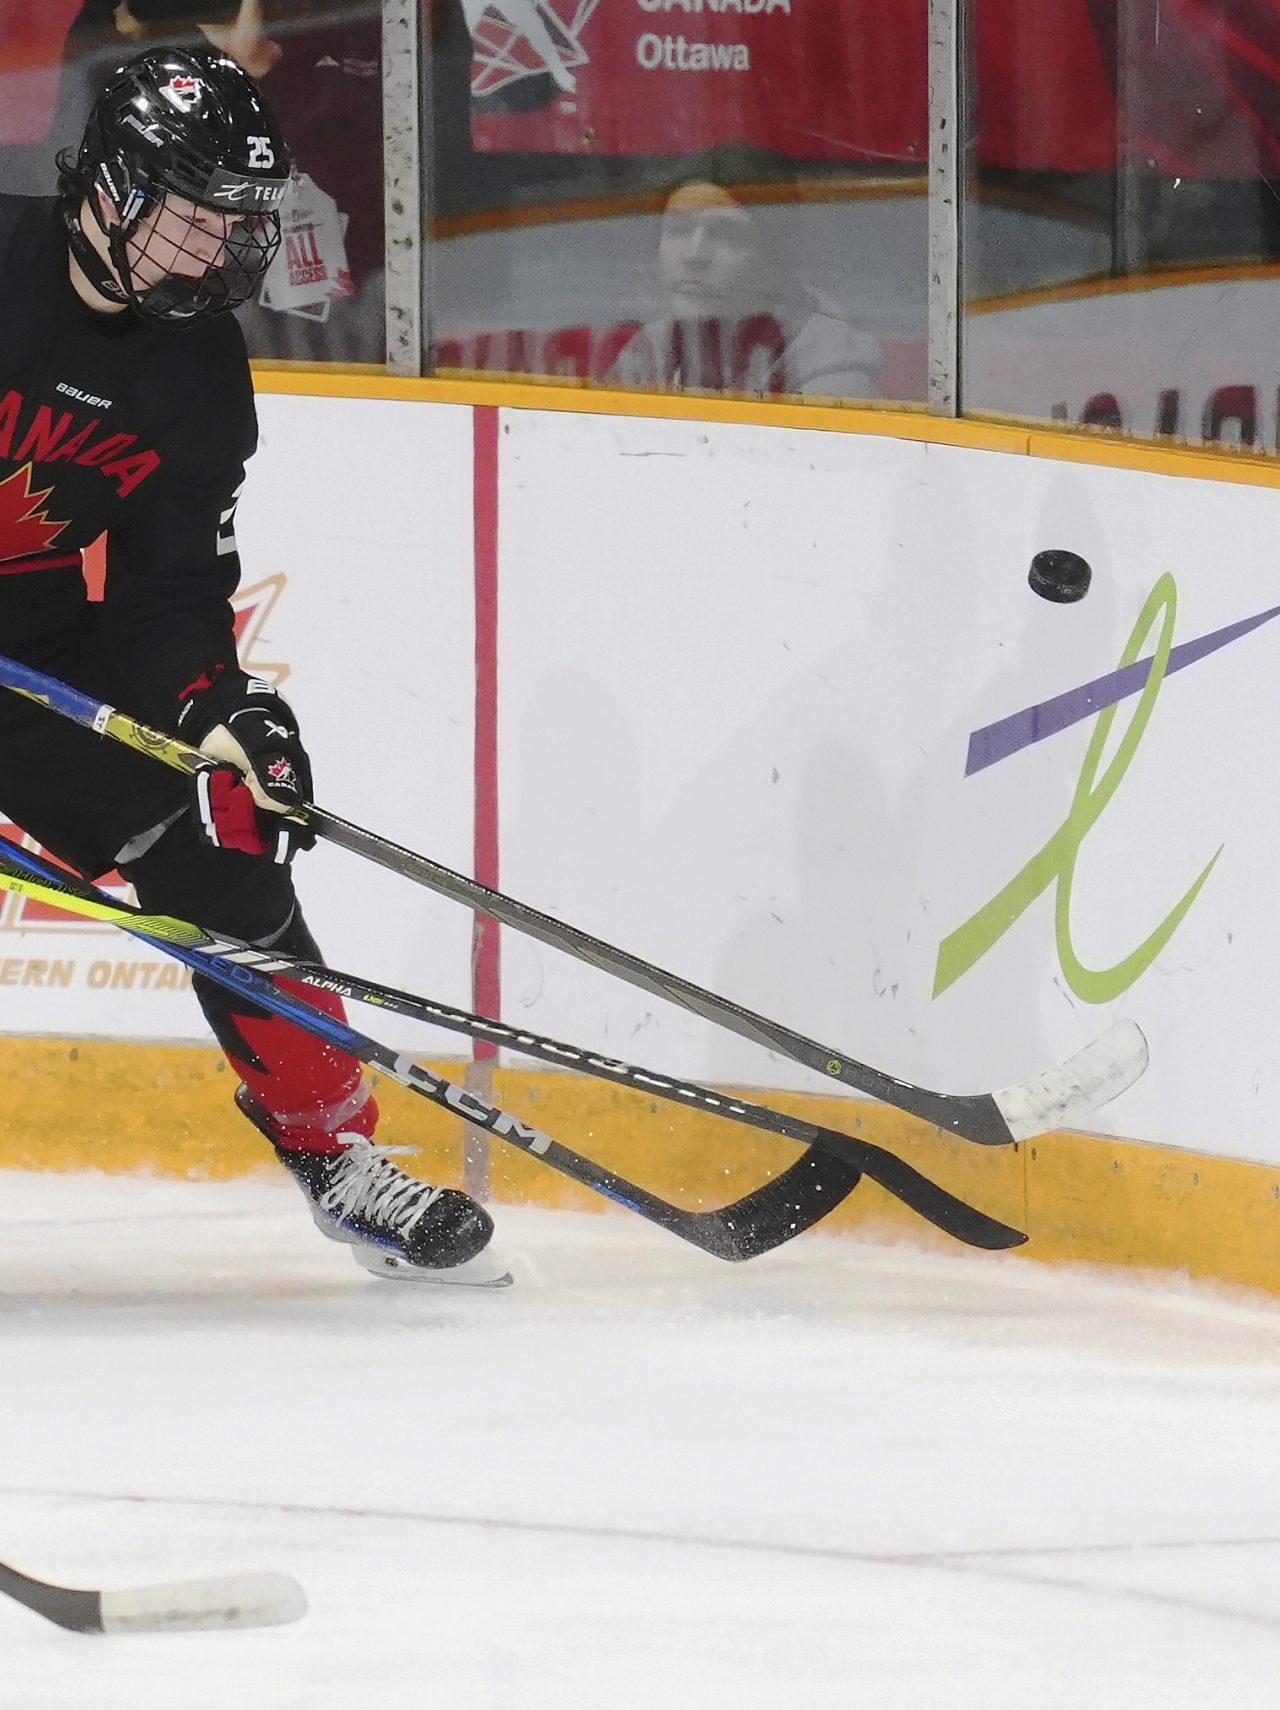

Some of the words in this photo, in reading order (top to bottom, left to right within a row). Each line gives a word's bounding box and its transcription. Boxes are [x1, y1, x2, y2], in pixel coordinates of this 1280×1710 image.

[636, 32, 751, 71] Ottawa
[246, 135, 275, 169] 25
[286, 231, 324, 269] ALL
[55, 382, 113, 410] BAUER
[301, 975, 353, 997] ALPHA
[393, 1052, 553, 1156] CCM
